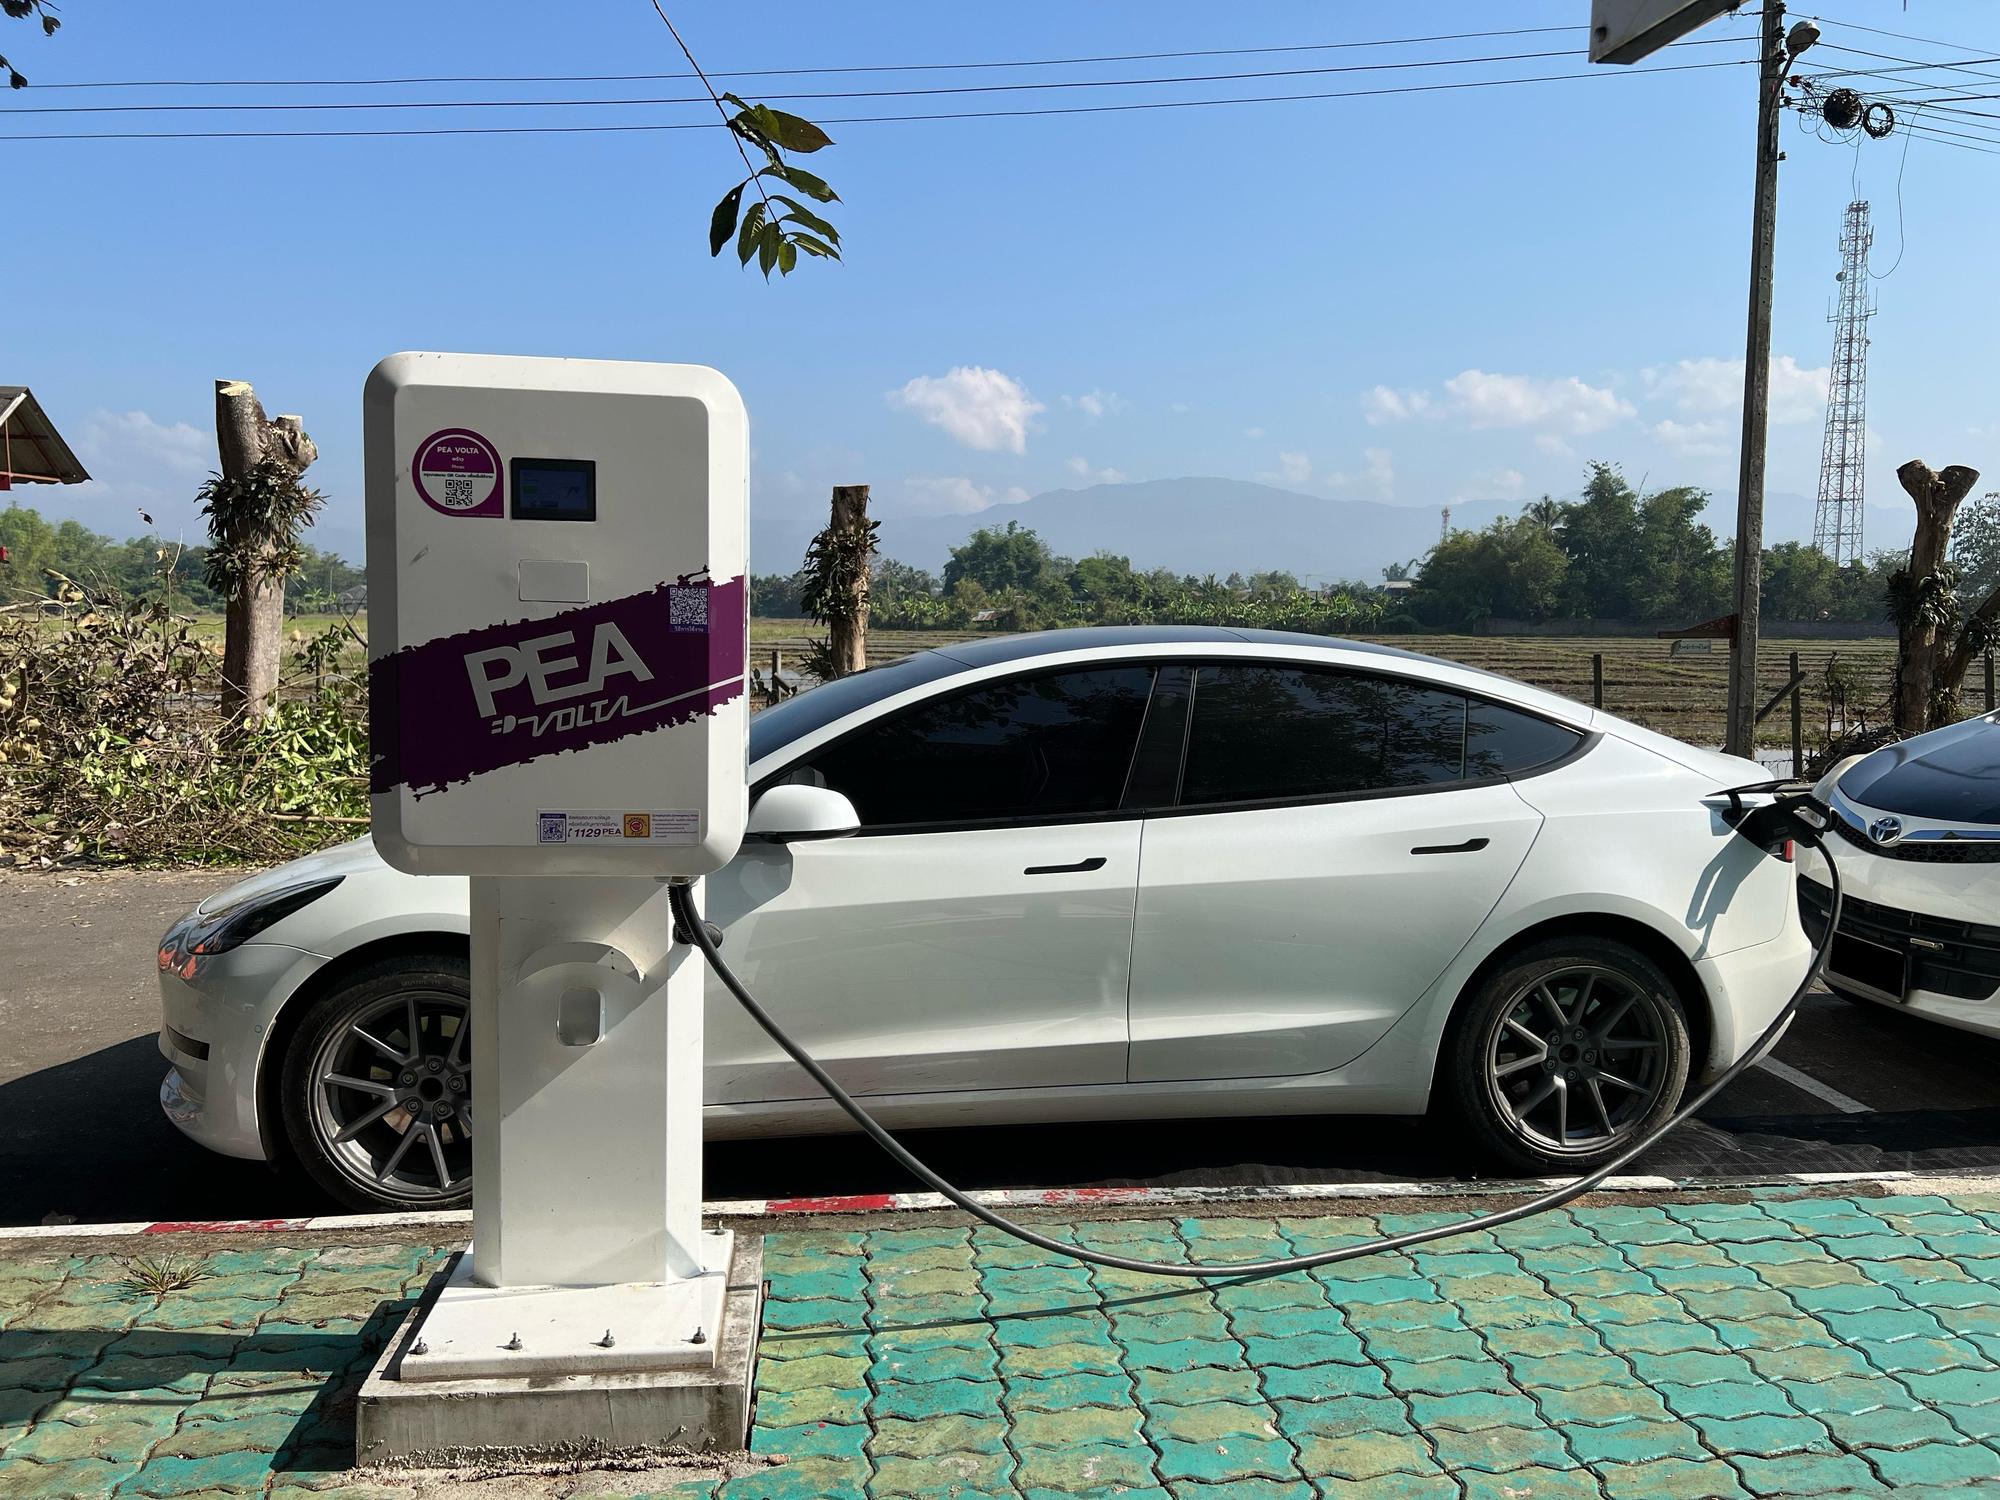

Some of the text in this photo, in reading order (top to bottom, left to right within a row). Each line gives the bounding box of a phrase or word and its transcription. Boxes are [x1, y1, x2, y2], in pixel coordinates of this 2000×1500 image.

[464, 622, 655, 718] PEA
[517, 695, 629, 738] VOLTA
[574, 828, 602, 838] 1129
